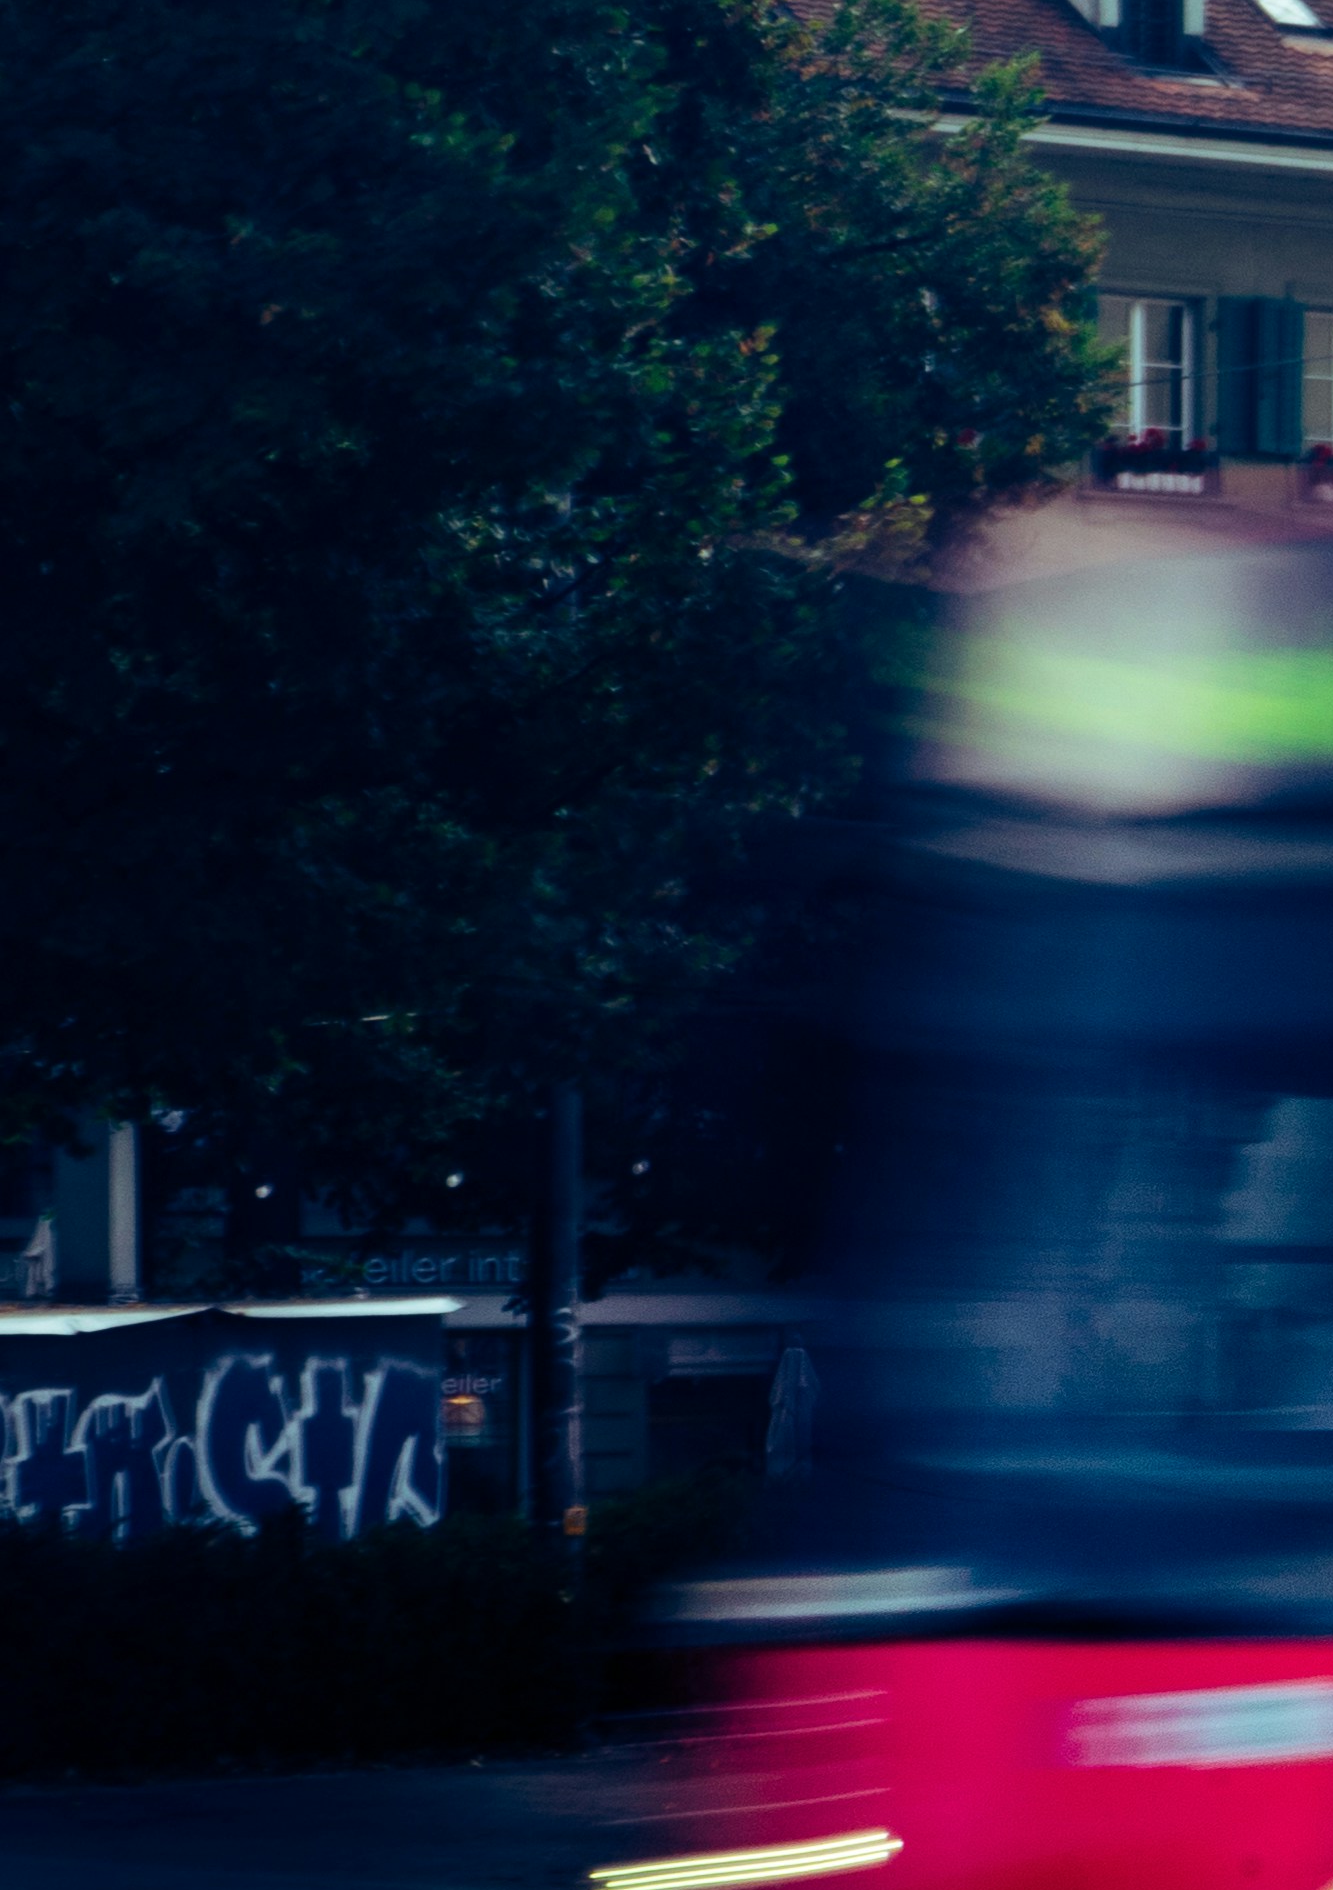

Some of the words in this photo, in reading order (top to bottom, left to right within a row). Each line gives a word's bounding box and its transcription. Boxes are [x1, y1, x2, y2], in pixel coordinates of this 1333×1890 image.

[364, 1249, 456, 1284] eiler
[468, 1248, 521, 1283] int
[441, 1374, 502, 1395] eiler
